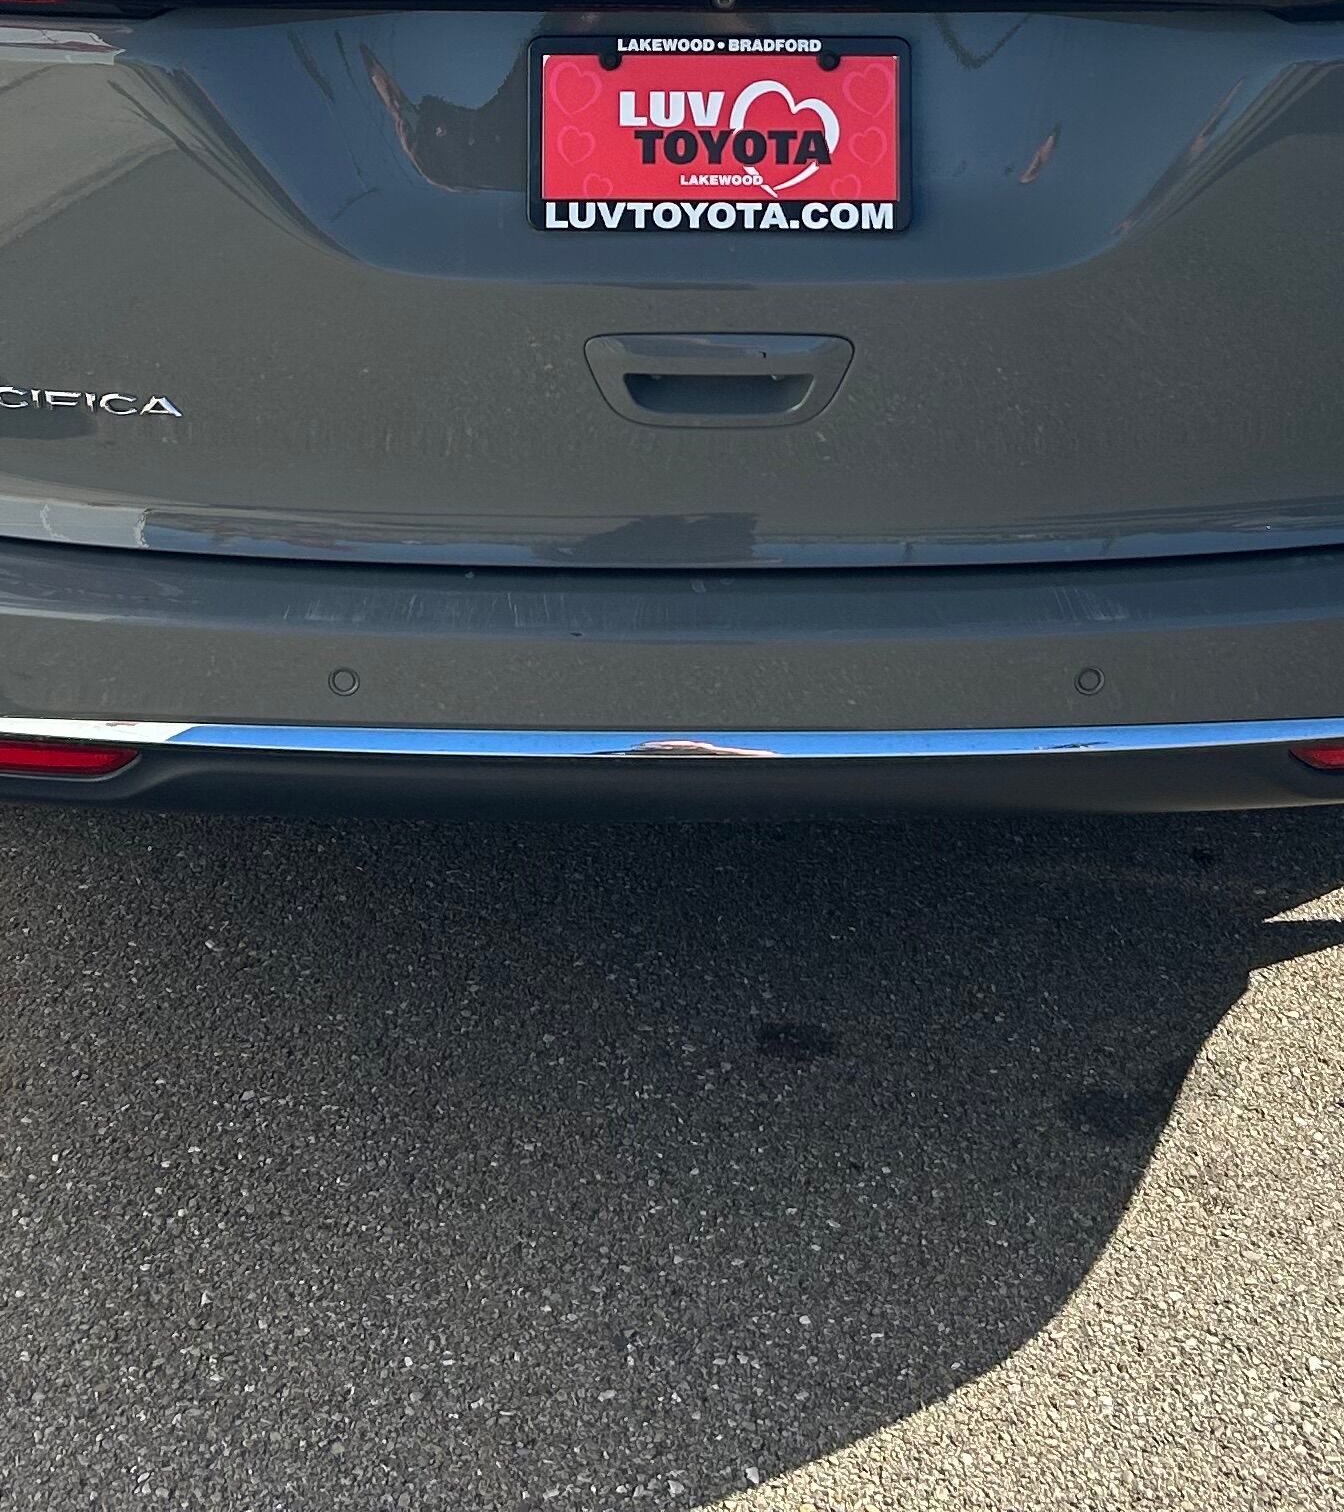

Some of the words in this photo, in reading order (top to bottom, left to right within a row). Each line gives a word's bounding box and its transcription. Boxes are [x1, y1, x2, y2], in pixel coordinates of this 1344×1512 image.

[617, 38, 715, 52] LAKEWOOD
[728, 39, 822, 53] BRADFORD
[619, 91, 725, 128] LUV
[634, 130, 832, 165] TOYOTA
[680, 174, 764, 186] LAKEWOOD
[545, 201, 894, 230] LUVTOYOTA.COM
